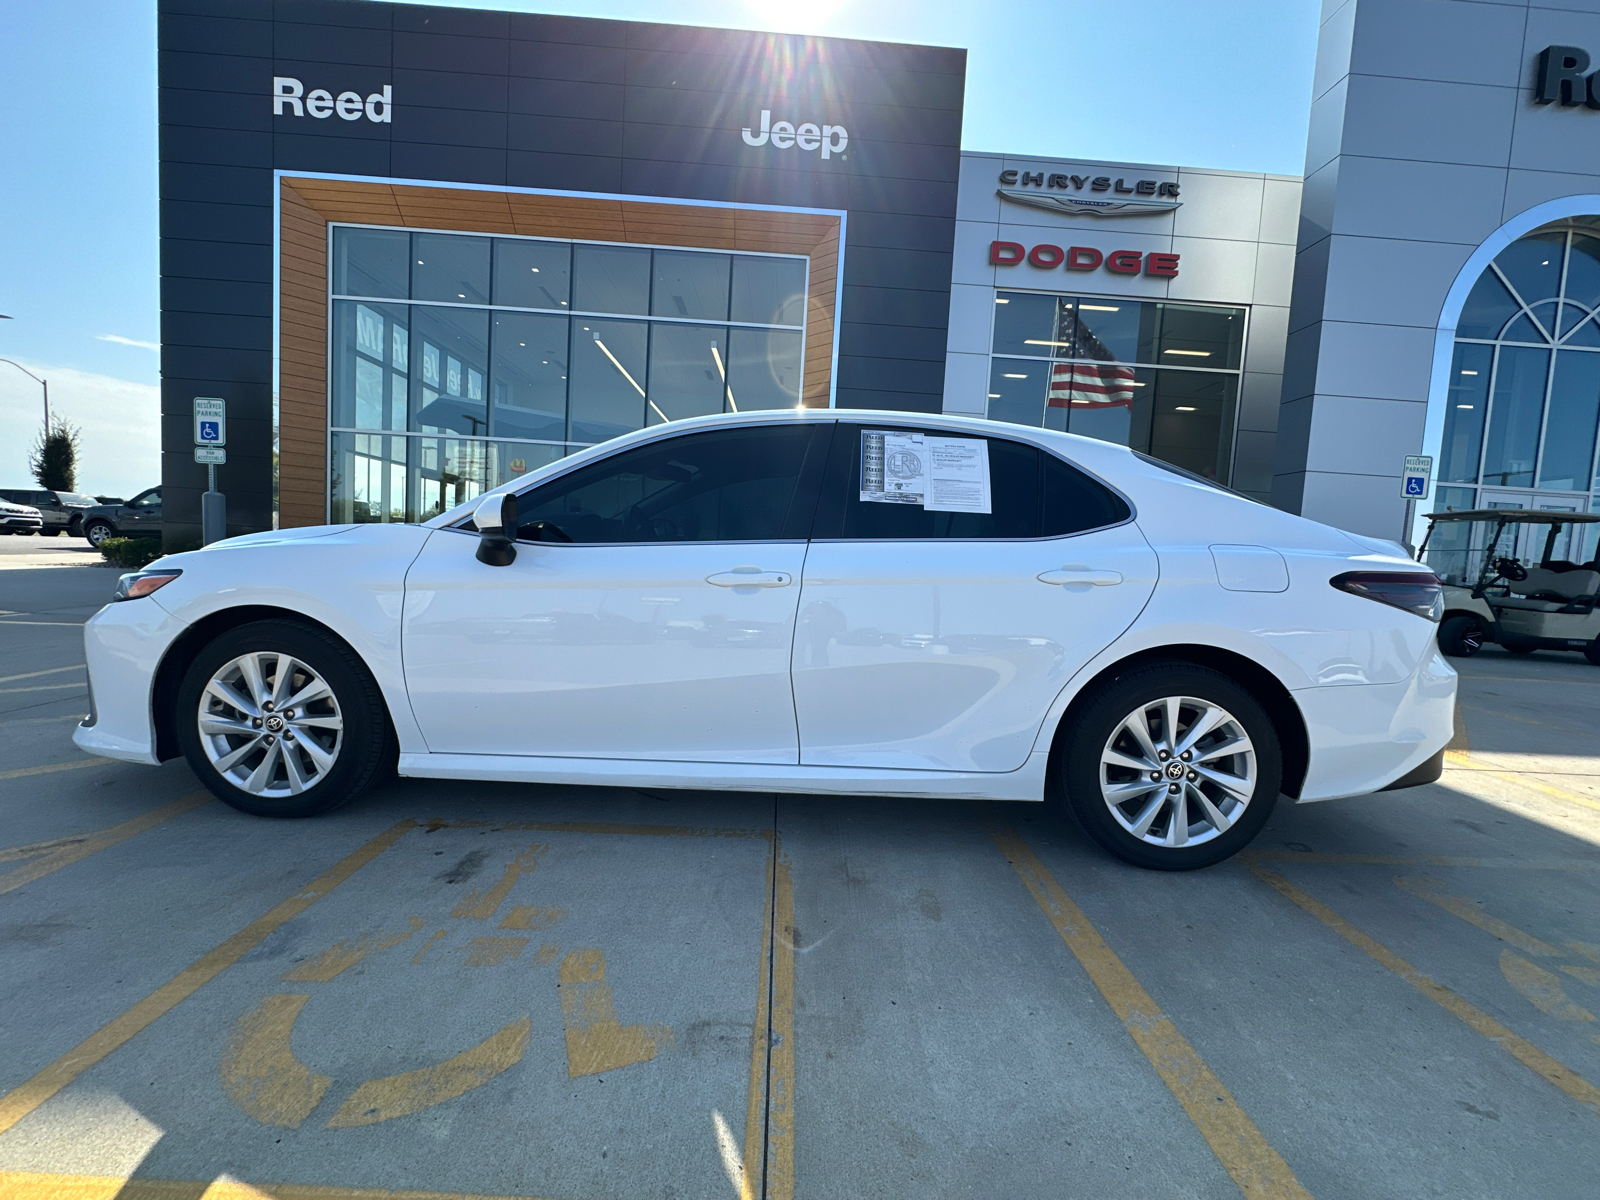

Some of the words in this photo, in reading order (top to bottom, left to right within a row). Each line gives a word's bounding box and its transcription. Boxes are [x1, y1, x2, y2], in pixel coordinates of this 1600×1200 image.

[1535, 45, 1600, 109] R
[273, 76, 392, 123] Reed
[741, 109, 849, 160] Jeep
[1000, 169, 1181, 197] CHRYSLER
[989, 240, 1181, 280] DODGE
[197, 402, 222, 410] RESERVED
